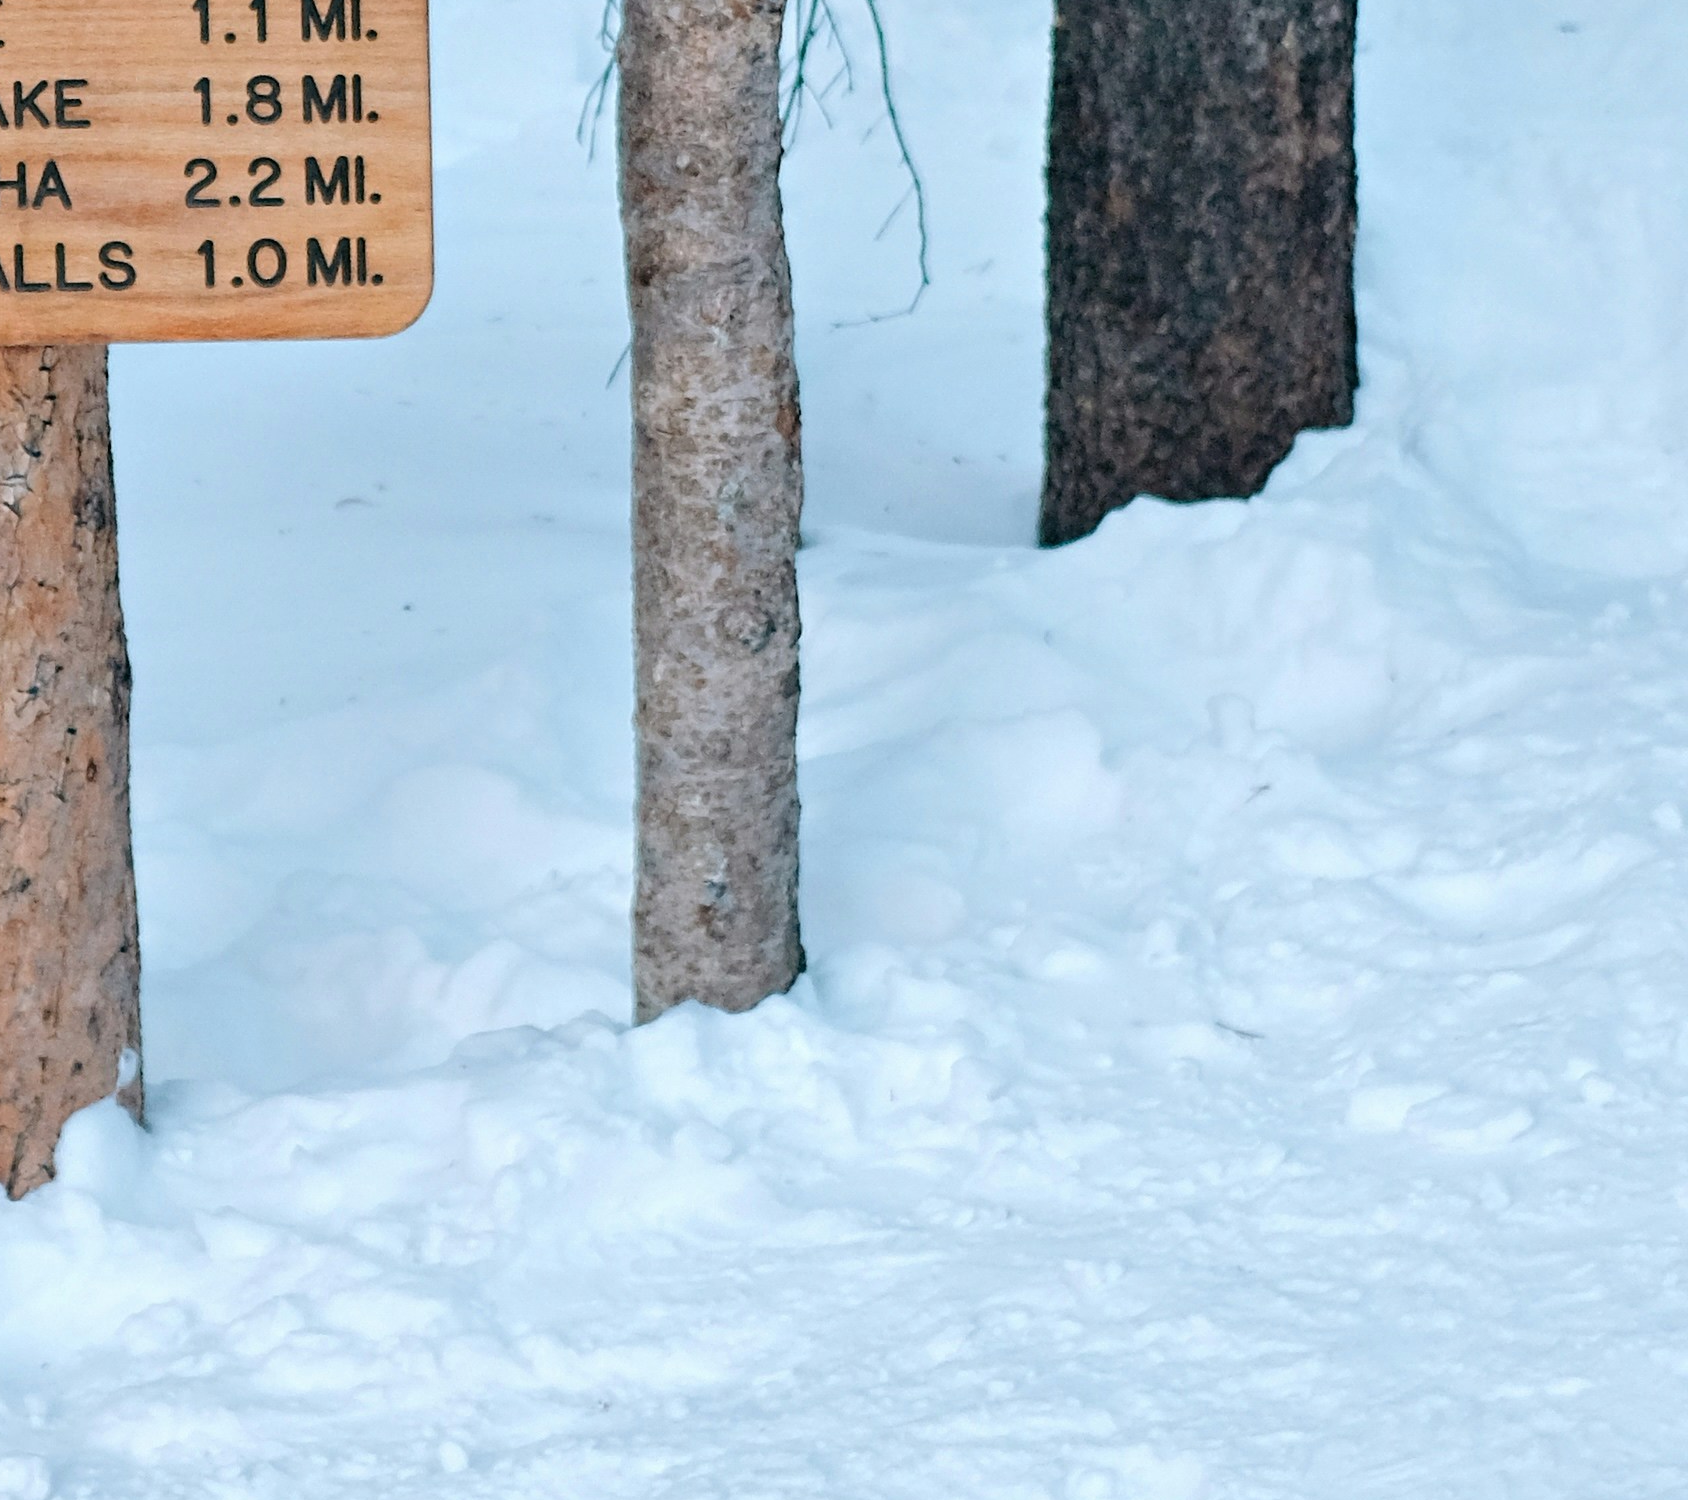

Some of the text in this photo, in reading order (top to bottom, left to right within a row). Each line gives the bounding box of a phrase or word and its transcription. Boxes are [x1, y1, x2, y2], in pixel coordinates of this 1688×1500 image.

[193, 74, 283, 126] 1.8
[301, 73, 379, 124] MI.
[184, 156, 285, 209] 2.2
[304, 155, 382, 205] MI.
[197, 238, 287, 289] 1.0
[306, 236, 384, 287] MI.
